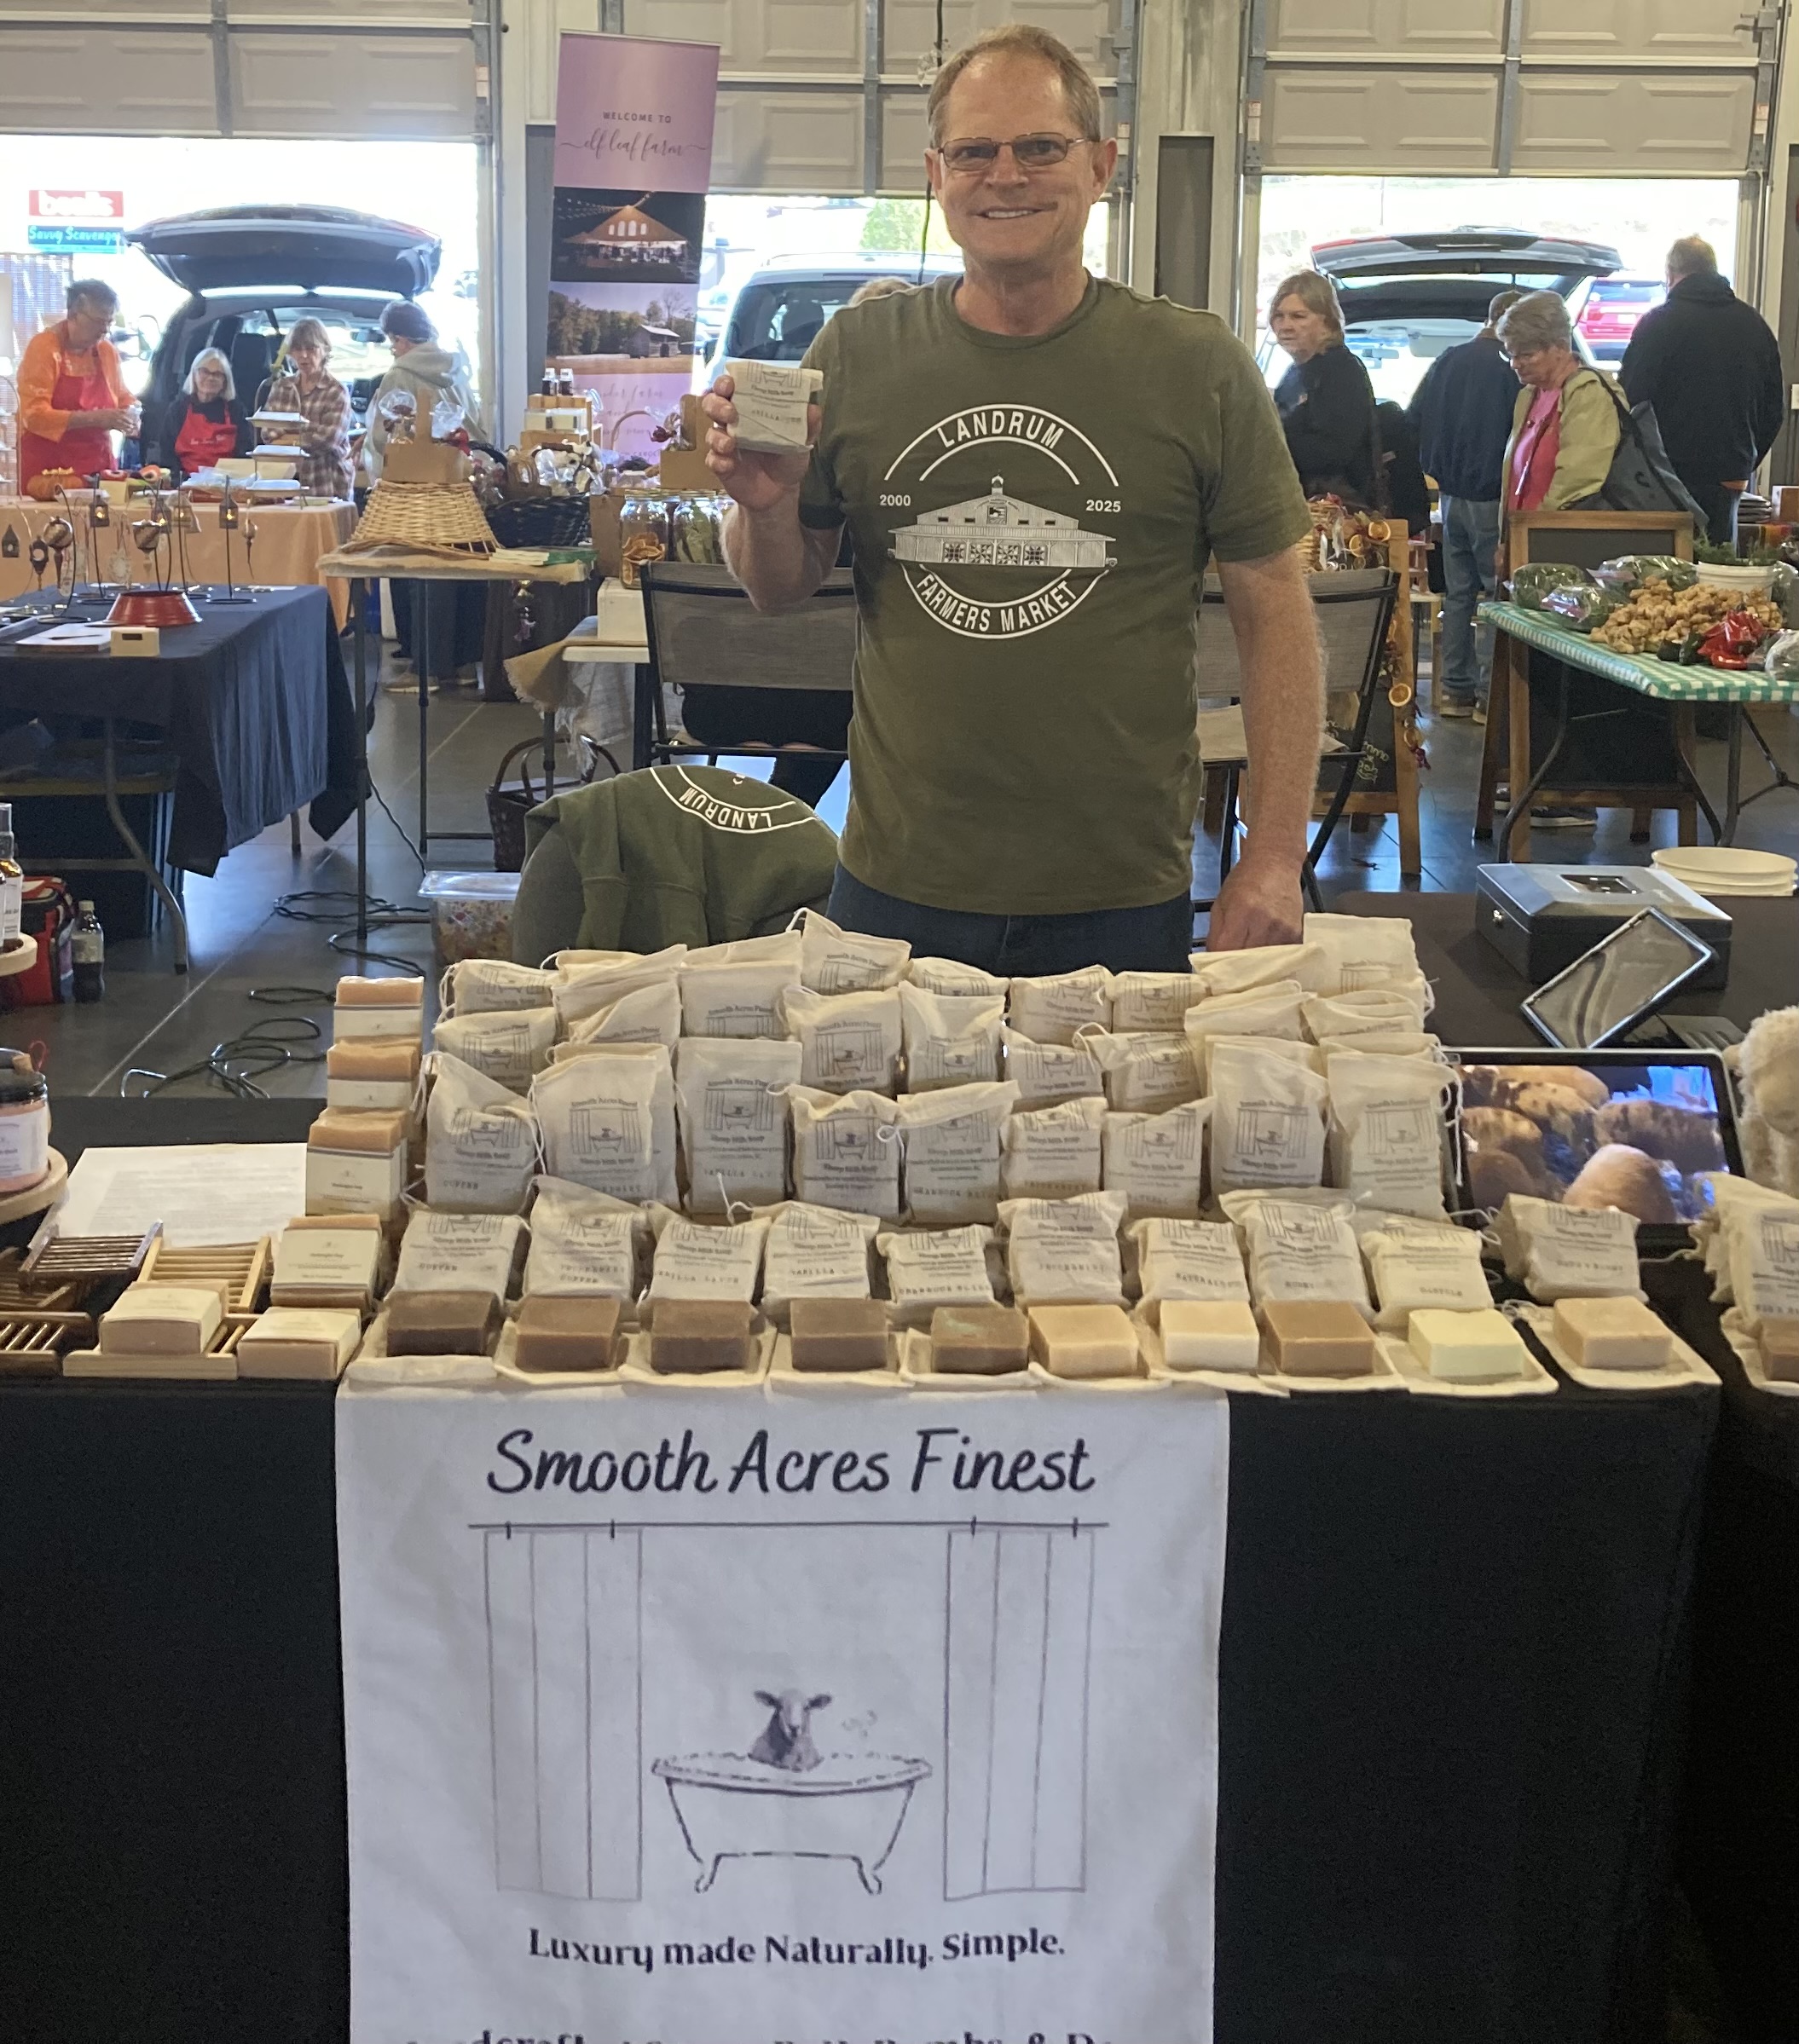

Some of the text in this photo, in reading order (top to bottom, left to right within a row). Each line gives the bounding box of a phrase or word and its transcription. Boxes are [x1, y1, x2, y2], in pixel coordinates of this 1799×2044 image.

[603, 112, 672, 124] WELCOME TO
[29, 225, 64, 245] Savvy
[937, 410, 1064, 449] LANDRUM
[879, 494, 911, 506] 2000
[1085, 499, 1121, 513] 2025
[917, 574, 1078, 632] FARMERS MARKET
[679, 787, 772, 829] LANDRUM
[487, 1427, 1096, 1494] Smooth Acres Finest
[529, 1926, 1065, 1974] Luxury made Naturally. Simple.
